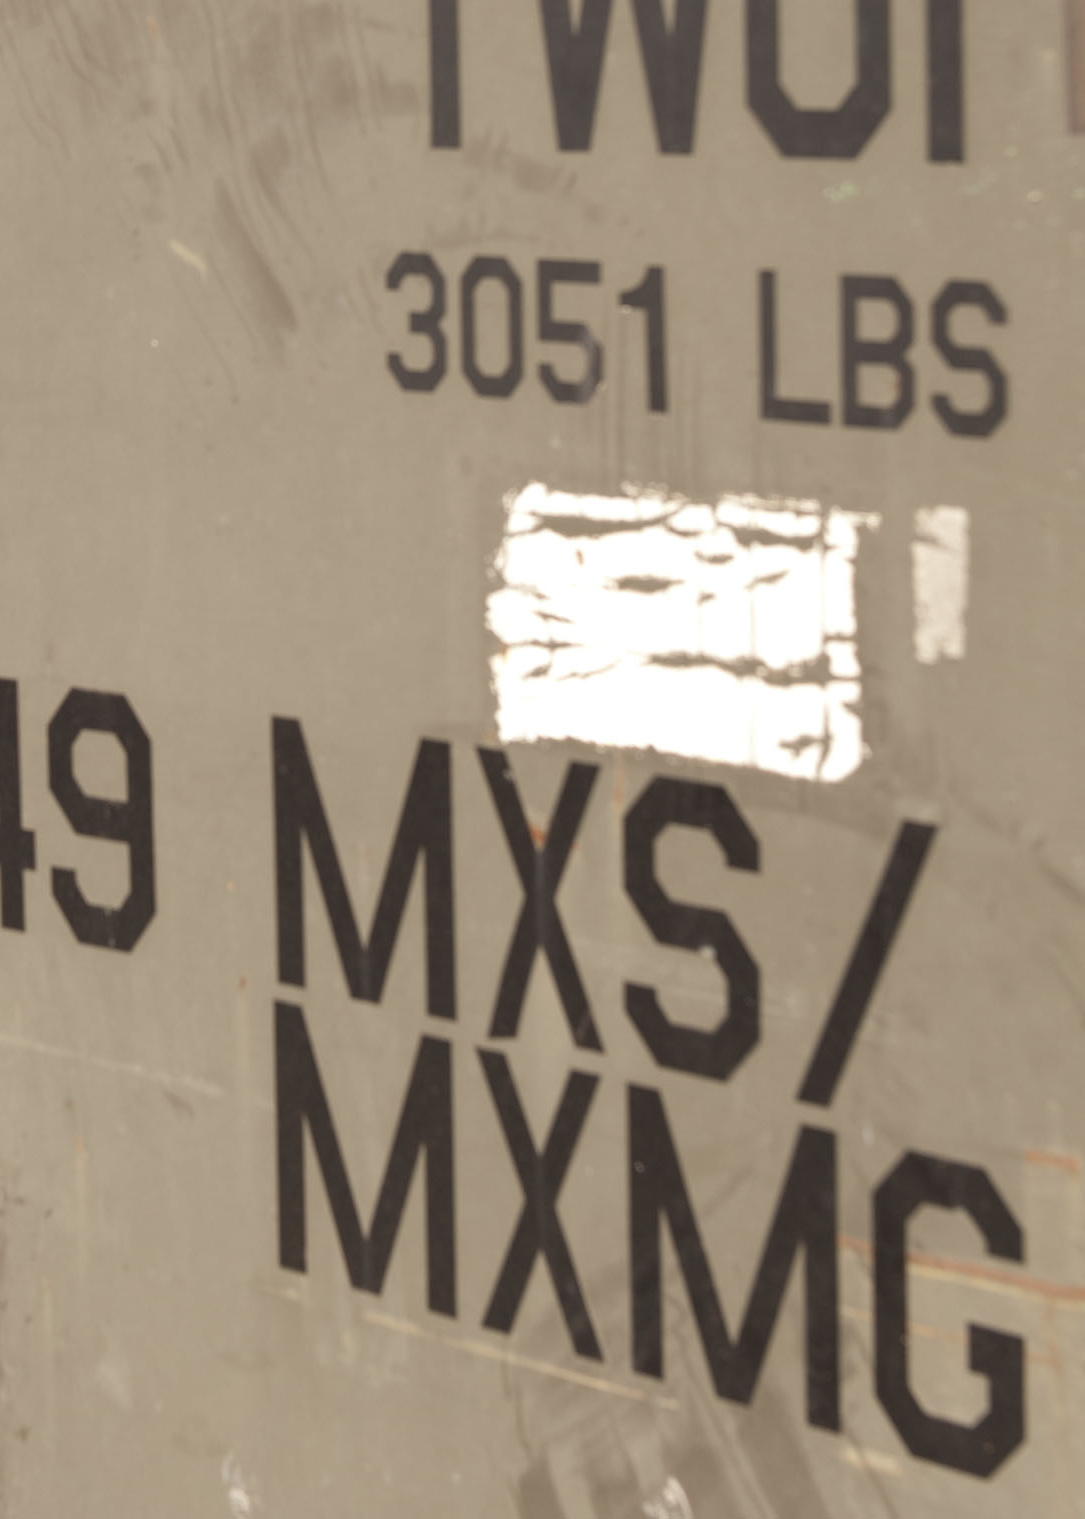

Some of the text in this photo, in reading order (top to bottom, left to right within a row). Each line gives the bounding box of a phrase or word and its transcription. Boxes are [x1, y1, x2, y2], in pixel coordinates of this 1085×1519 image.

[385, 250, 1010, 441] 3051 LBS
[273, 998, 1028, 1482] MXMG
